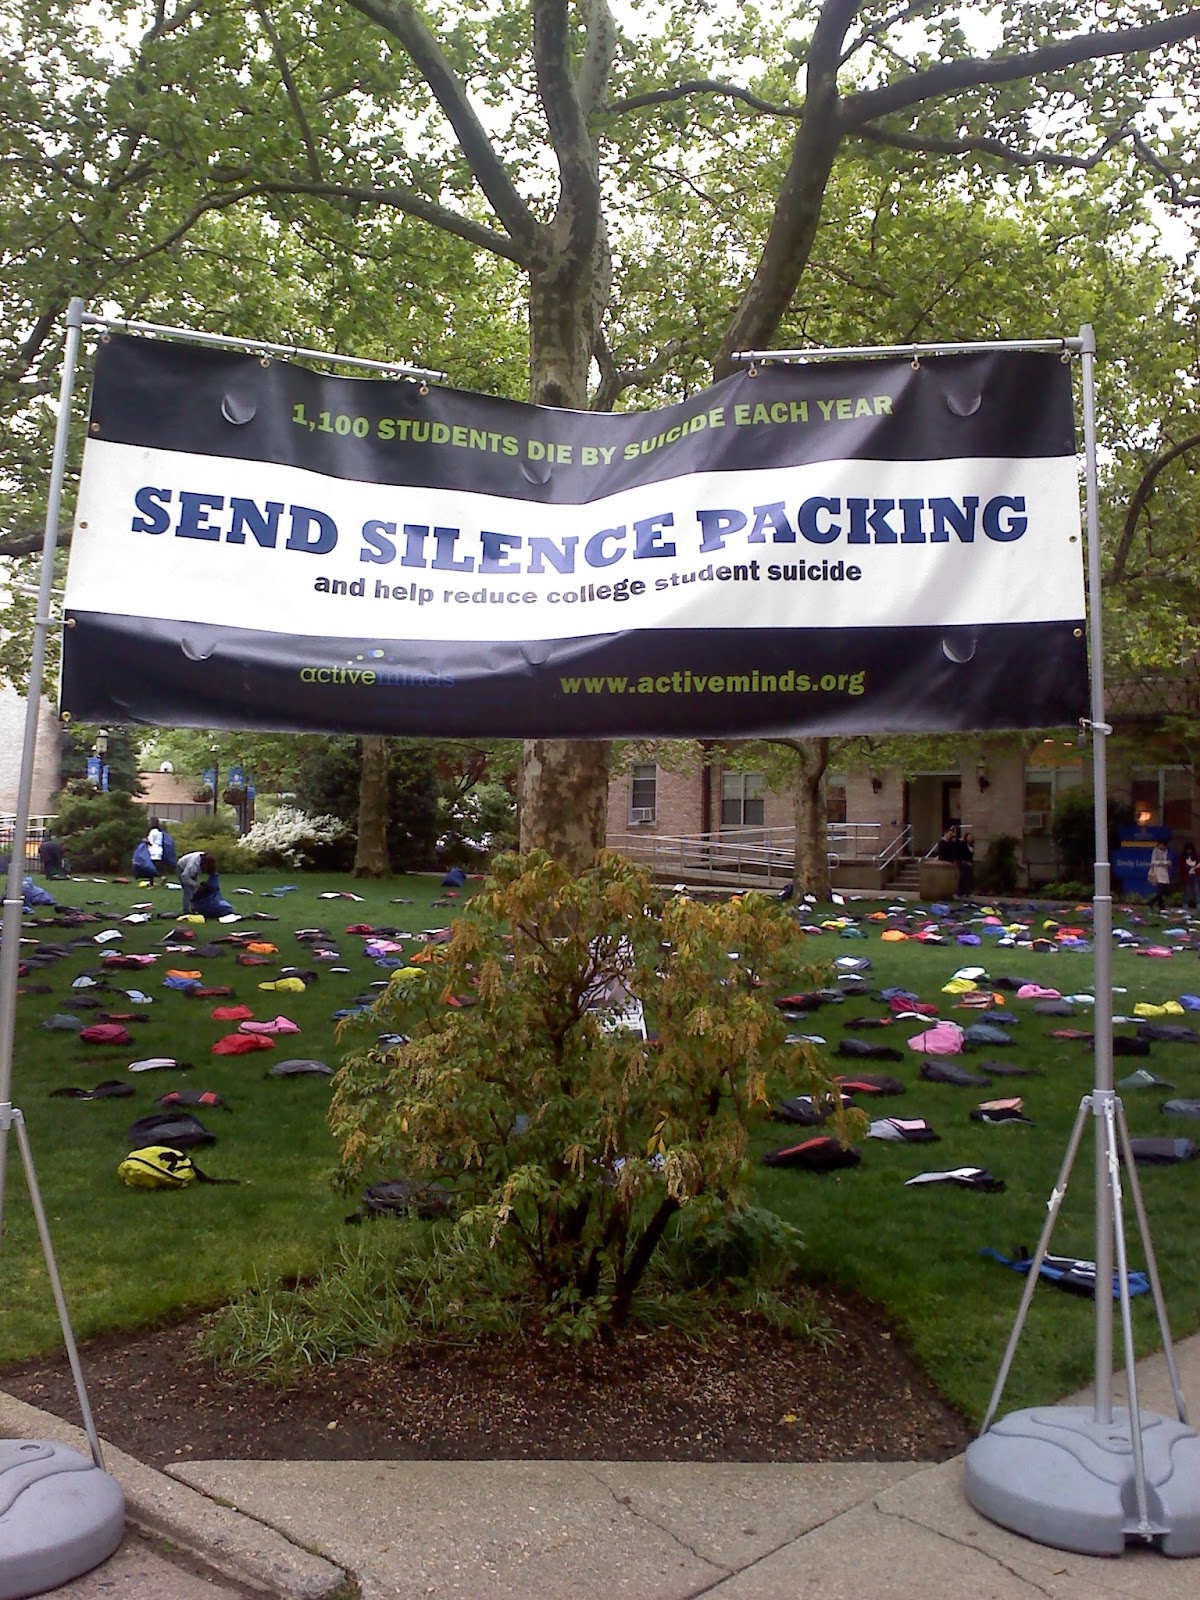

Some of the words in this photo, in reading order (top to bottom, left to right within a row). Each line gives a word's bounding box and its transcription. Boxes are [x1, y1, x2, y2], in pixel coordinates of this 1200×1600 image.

[292, 404, 369, 438] 1,100
[377, 417, 519, 456] STUDENTS
[528, 439, 573, 465] DIE
[582, 446, 616, 466] BY
[623, 406, 725, 461] SUICIDE
[734, 400, 808, 425] EACH
[818, 395, 894, 421] YEAR
[131, 486, 338, 554] SEND
[359, 512, 676, 575] SILENCE
[696, 495, 1028, 553] PACKING
[313, 575, 365, 598] and
[374, 579, 433, 606] help
[443, 587, 538, 604] reduce
[546, 577, 647, 602] college
[654, 559, 760, 591] student
[766, 559, 862, 581] suicide
[560, 668, 866, 696] www.activeminds.org
